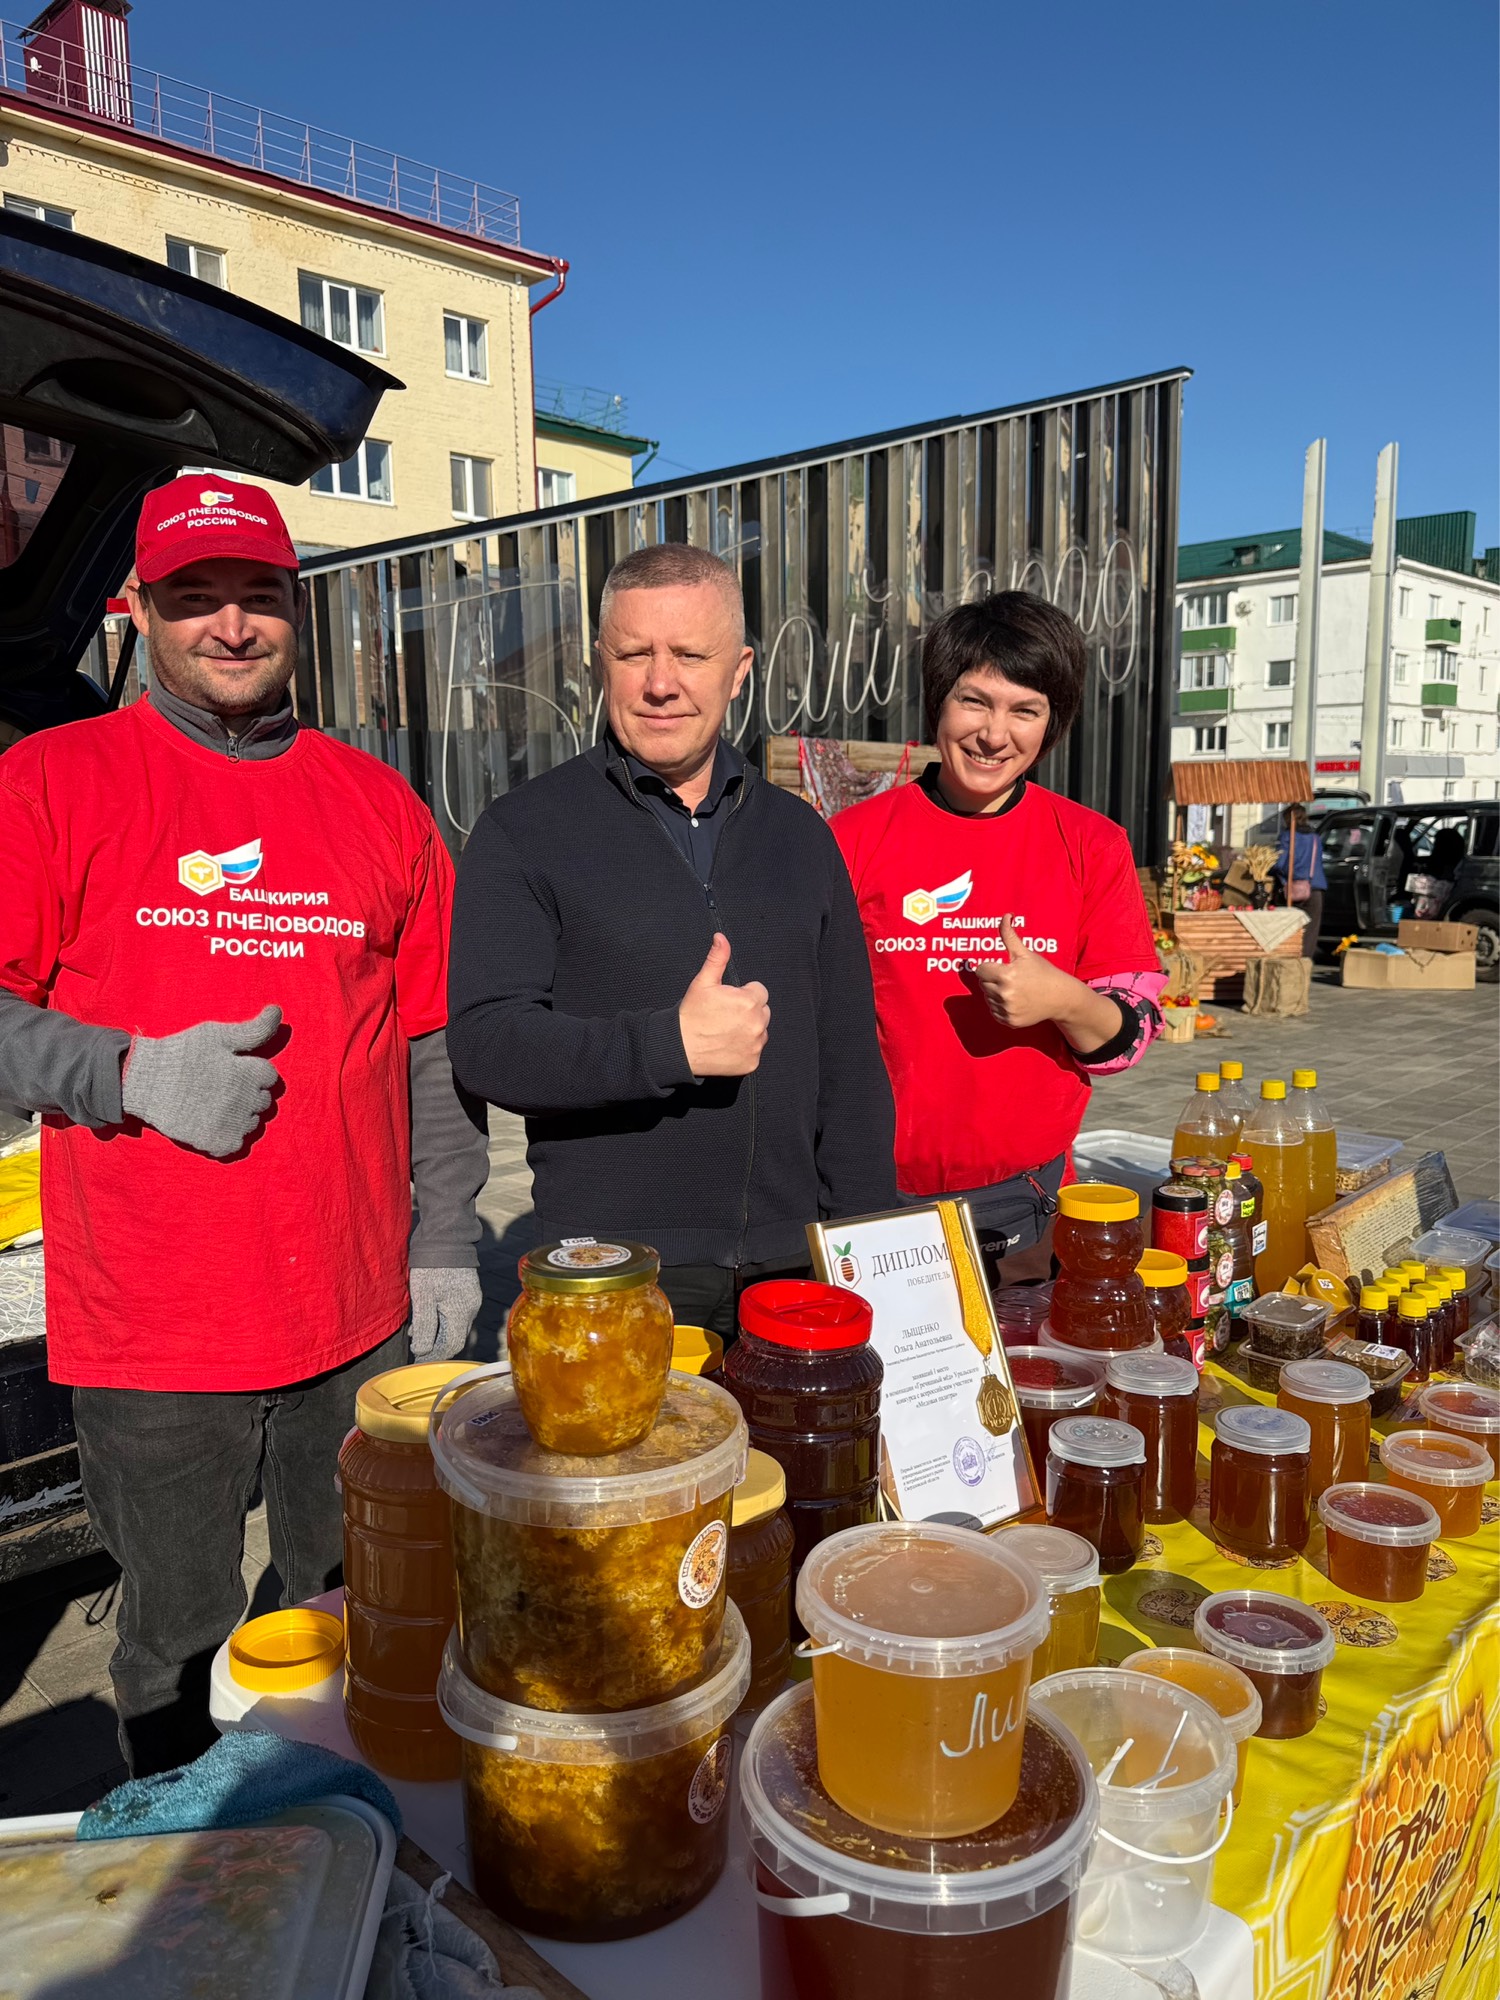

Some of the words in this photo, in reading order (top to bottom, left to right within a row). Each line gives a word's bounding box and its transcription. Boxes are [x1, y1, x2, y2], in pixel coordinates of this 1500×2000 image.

[157, 512, 186, 532] СОЮЗ
[188, 506, 268, 526] ПЧЕЛОВОДОВ
[187, 517, 237, 529] РОССИИ
[229, 887, 329, 905] БАШКИРИЯ
[136, 907, 209, 927] СОЮЗ
[217, 911, 365, 938] ПЧЕЛОВОДОВ
[210, 937, 305, 958] РОССИИ
[875, 936, 926, 953] СОЮЗ
[931, 937, 1058, 953] ПЧЕЛОВДОВ
[980, 1233, 1021, 1252] reme
[871, 1242, 949, 1279] ДИПЛОМ
[907, 1270, 951, 1288] ПОБЕДИТЕЛЬ
[893, 1342, 914, 1354] Ольга
[914, 1333, 953, 1350] Анатольевна
